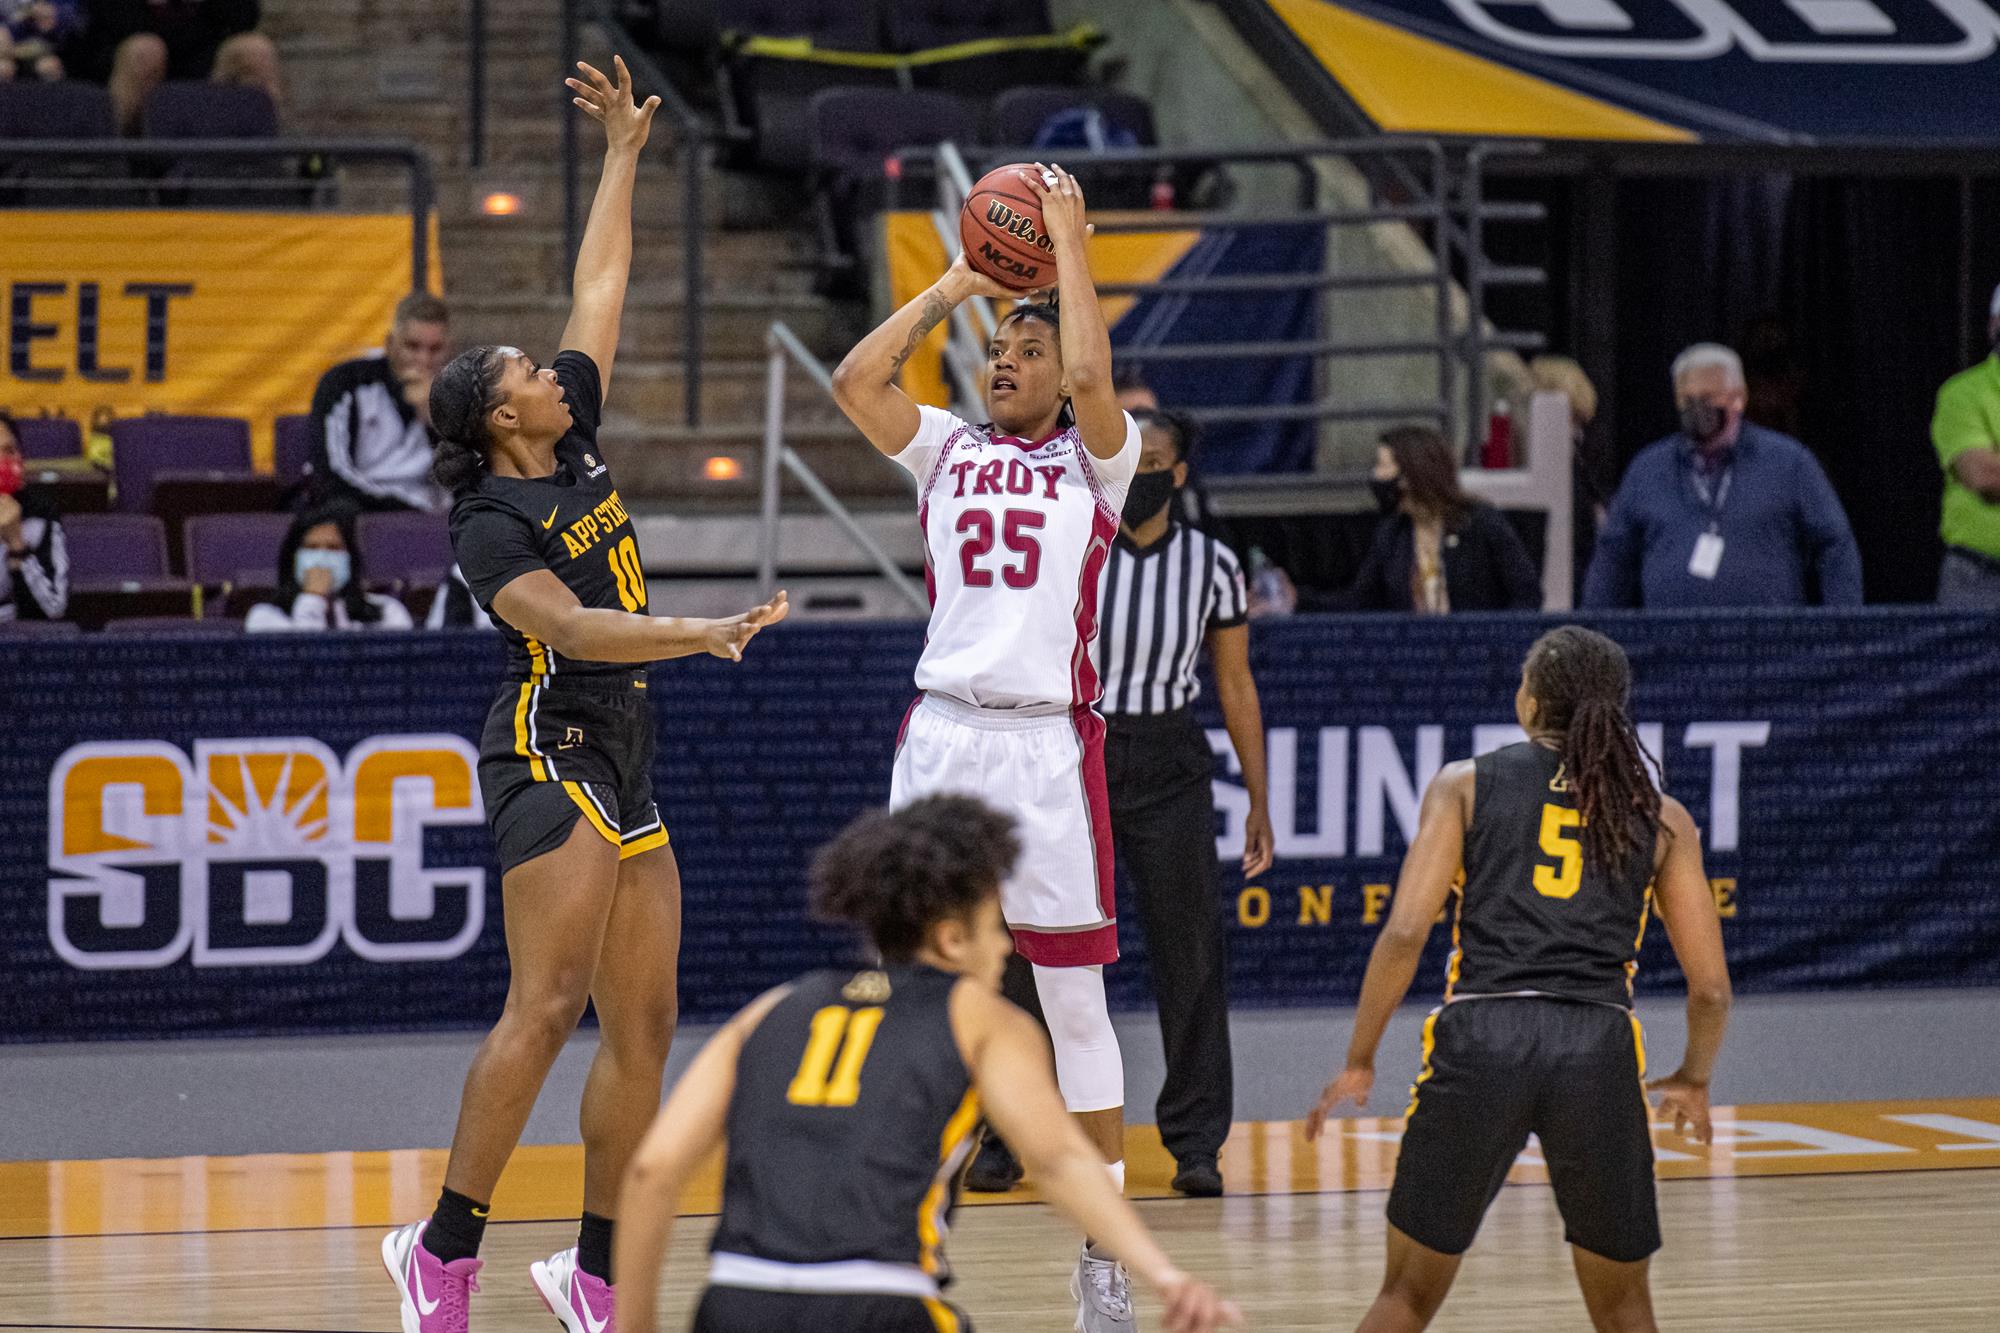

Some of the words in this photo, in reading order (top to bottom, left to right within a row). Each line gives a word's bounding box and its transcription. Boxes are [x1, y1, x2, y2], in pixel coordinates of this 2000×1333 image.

[978, 241, 1039, 280] NCAA
[10, 281, 195, 384] ELT
[949, 458, 1067, 501] TROY
[1030, 452, 1050, 460] SUN
[1051, 448, 1073, 459] BELT
[560, 514, 601, 560] APP
[593, 489, 629, 534] STAT
[955, 507, 1046, 590] 25
[607, 535, 647, 613] 10
[48, 732, 486, 969] SBC
[1532, 802, 1588, 899] 5
[786, 1004, 885, 1107] 11
